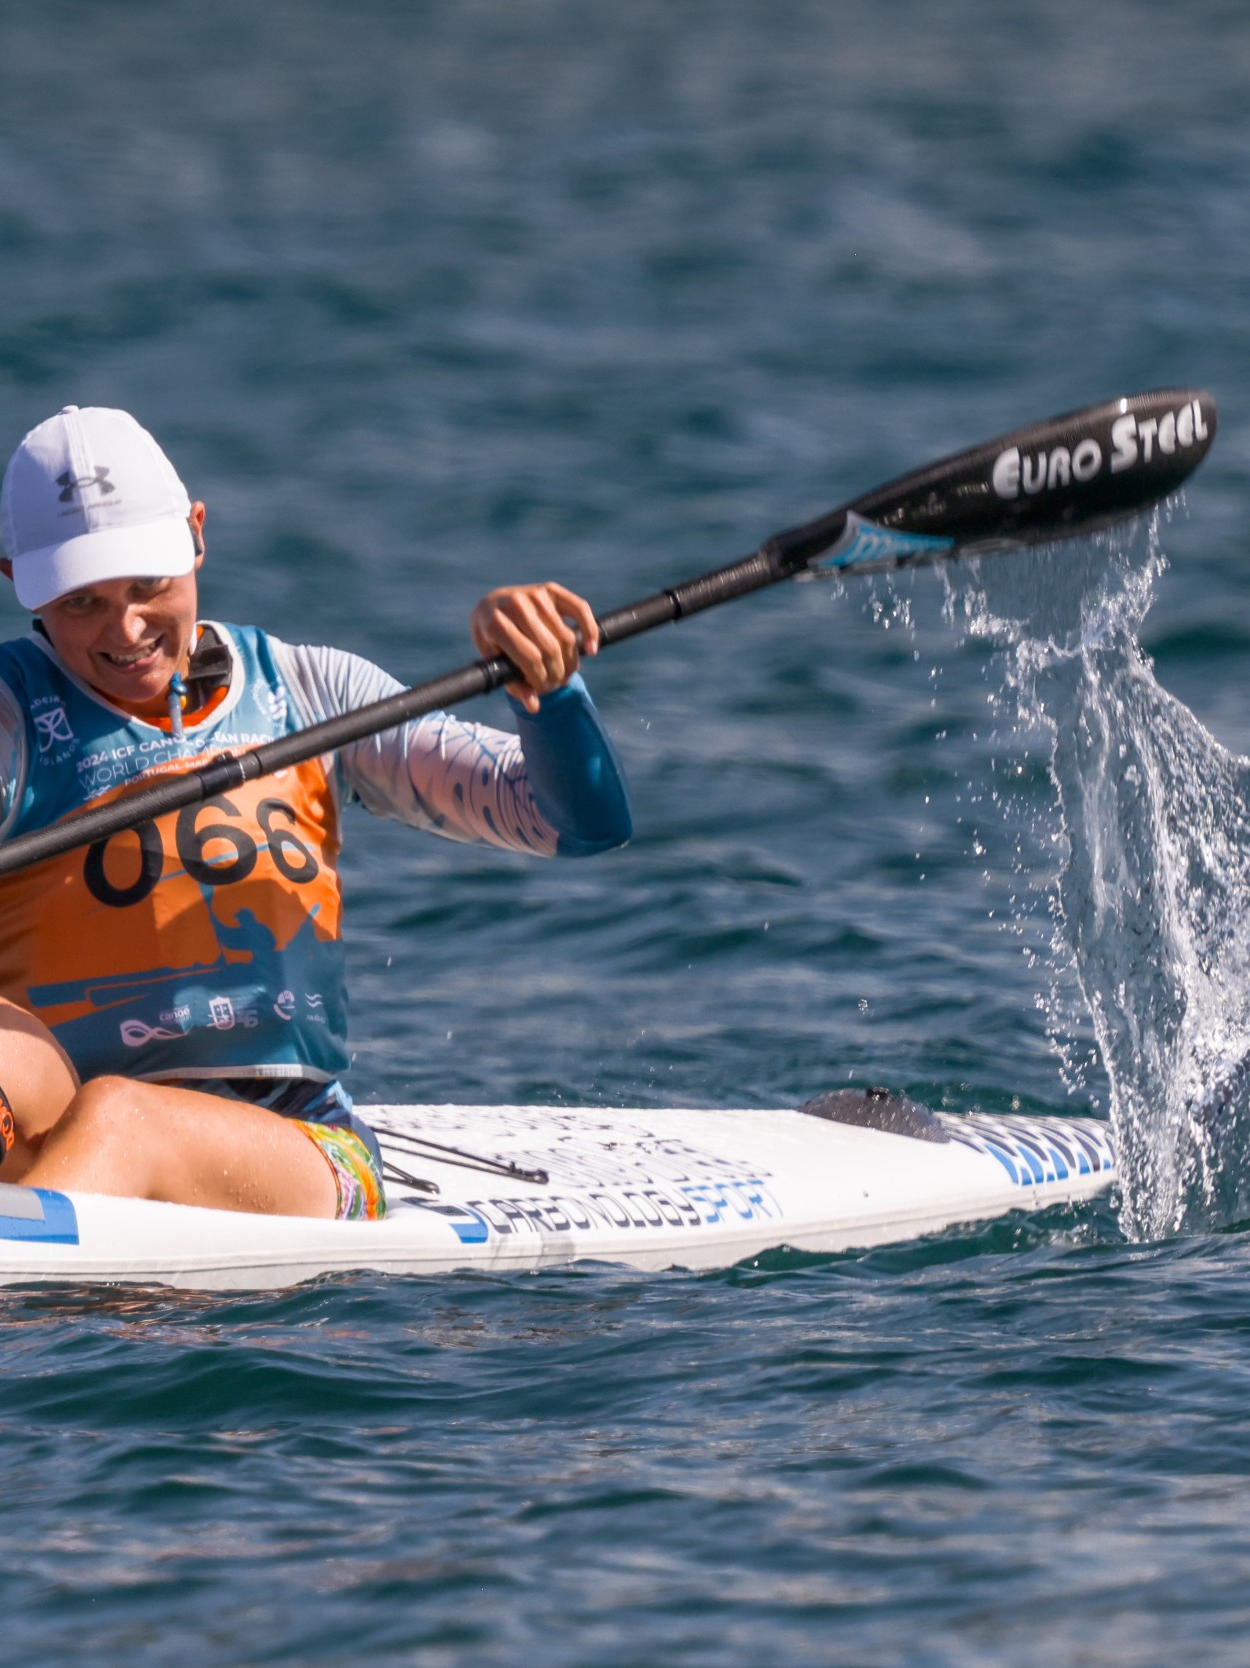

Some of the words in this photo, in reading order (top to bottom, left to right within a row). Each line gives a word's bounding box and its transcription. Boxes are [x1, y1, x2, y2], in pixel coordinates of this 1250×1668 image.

[992, 438, 1103, 499] EURO
[76, 750, 110, 773] 2024
[111, 744, 136, 760] ICF
[78, 755, 150, 790] WORLD
[83, 793, 320, 908] 066
